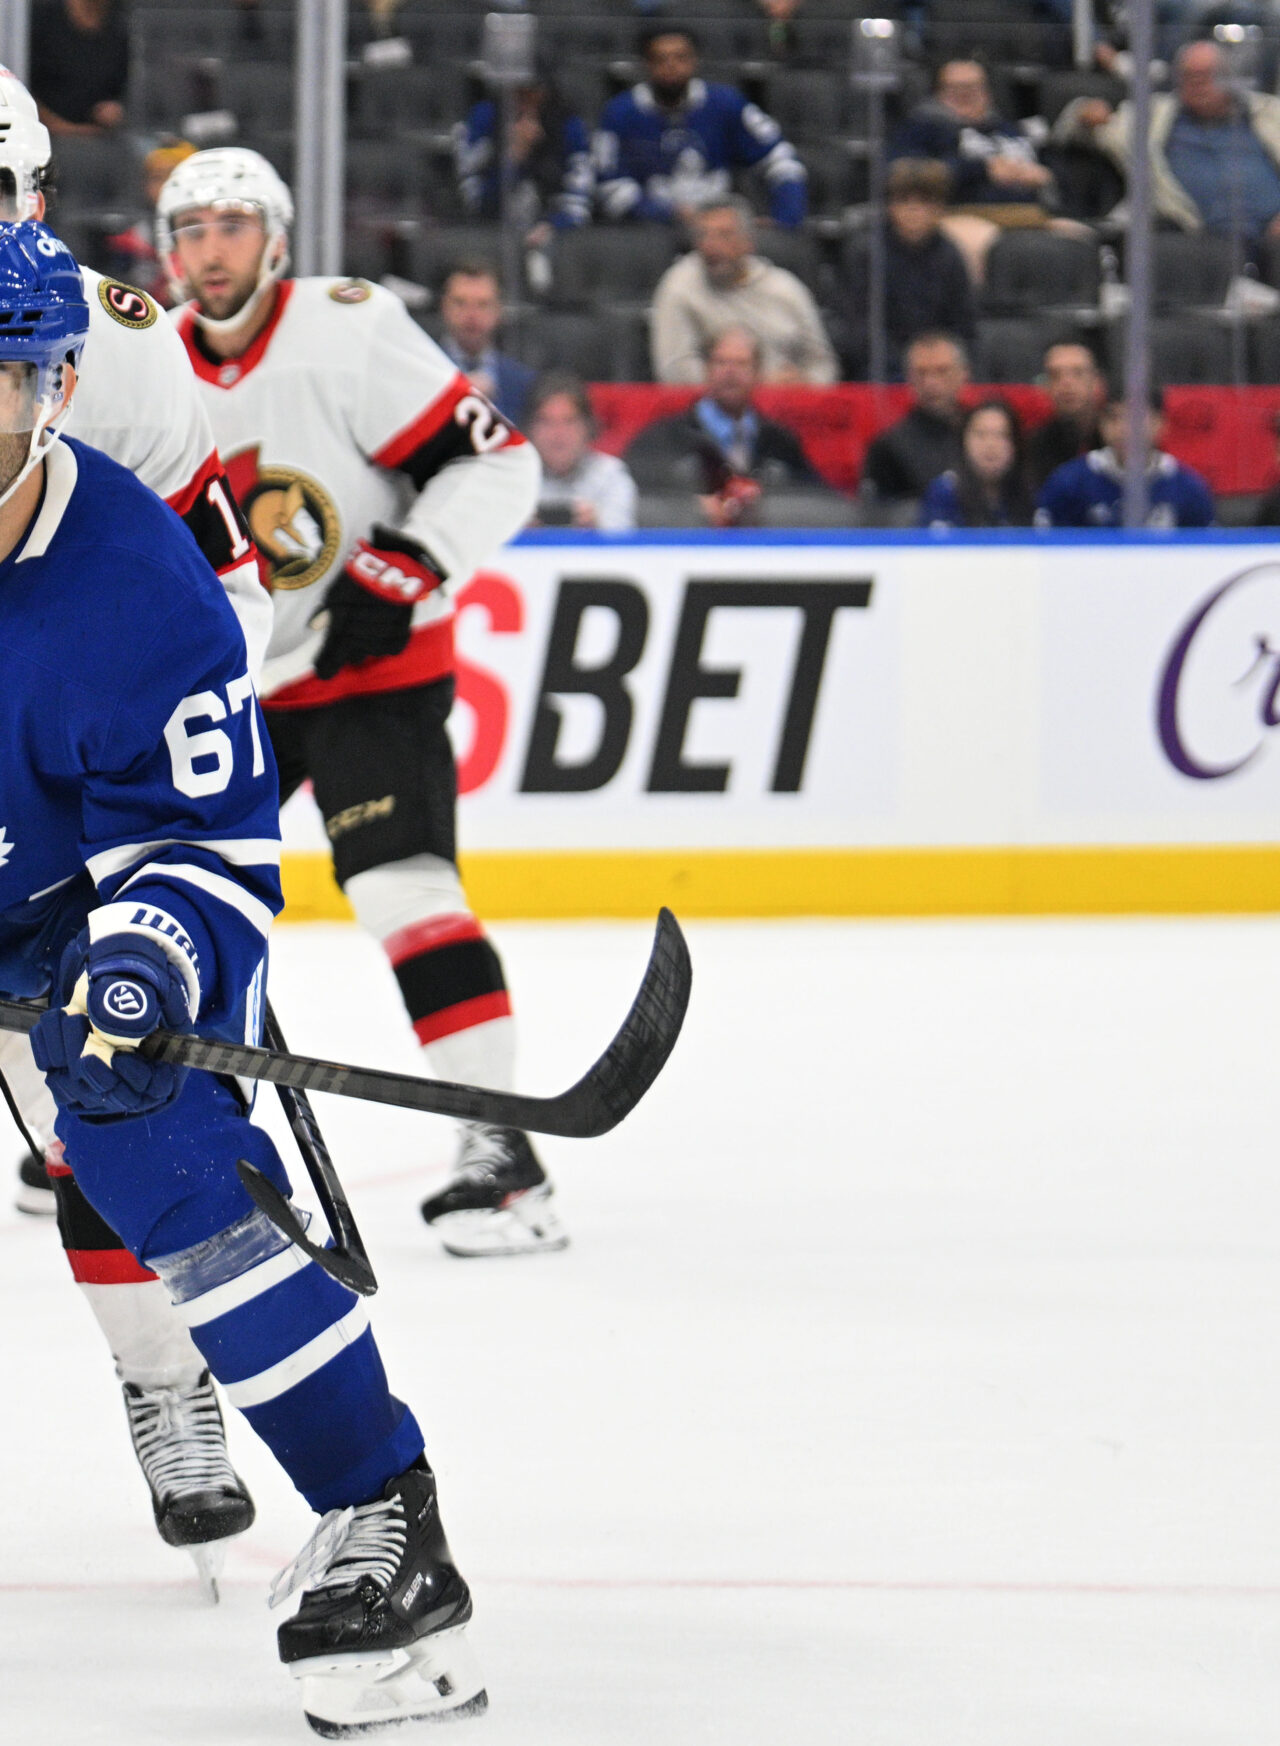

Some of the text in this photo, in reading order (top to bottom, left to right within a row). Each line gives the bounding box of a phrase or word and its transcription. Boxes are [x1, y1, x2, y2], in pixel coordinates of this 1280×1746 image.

[109, 286, 147, 318] S
[351, 549, 424, 598] CM
[163, 671, 266, 799] 67
